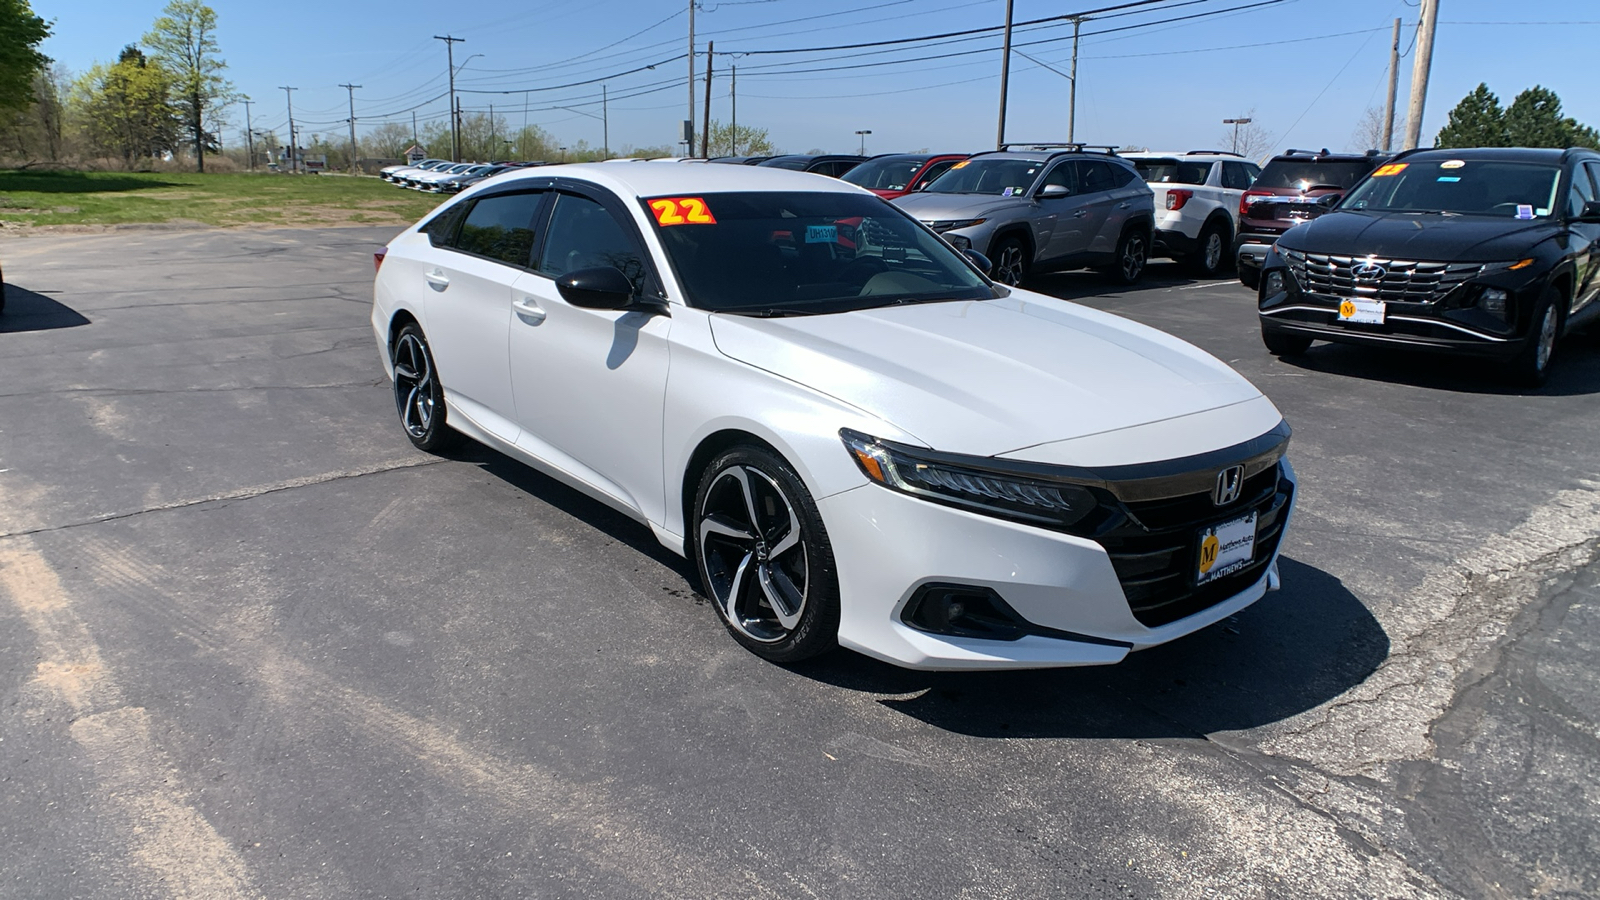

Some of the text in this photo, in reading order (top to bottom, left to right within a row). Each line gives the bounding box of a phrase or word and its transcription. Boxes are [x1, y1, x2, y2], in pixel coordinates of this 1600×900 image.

[652, 199, 711, 224] 22
[1343, 305, 1354, 314] M
[1201, 543, 1217, 566] M
[1219, 538, 1241, 552] Matthews
[1210, 560, 1244, 582] MATTHEWS
